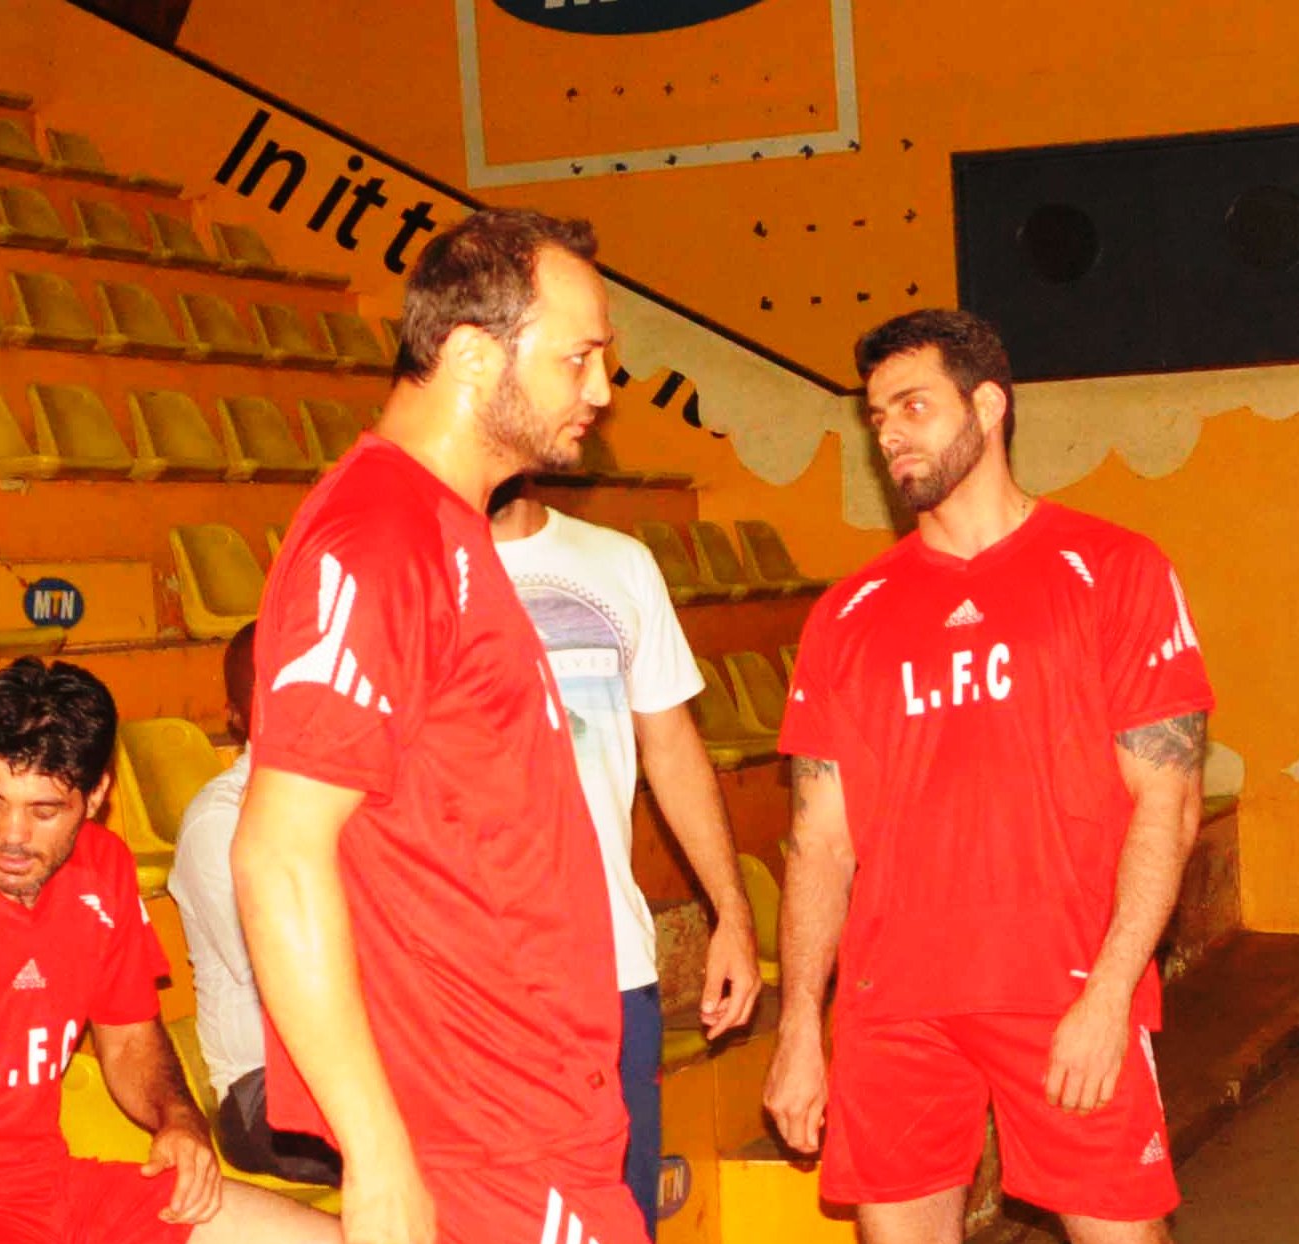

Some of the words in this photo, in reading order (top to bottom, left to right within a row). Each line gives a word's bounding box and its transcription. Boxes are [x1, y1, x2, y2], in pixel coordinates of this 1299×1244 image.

[214, 109, 308, 214] In
[307, 154, 388, 251] it
[384, 202, 438, 274] t
[33, 590, 75, 620] MTN
[901, 642, 1012, 716] L.F.C
